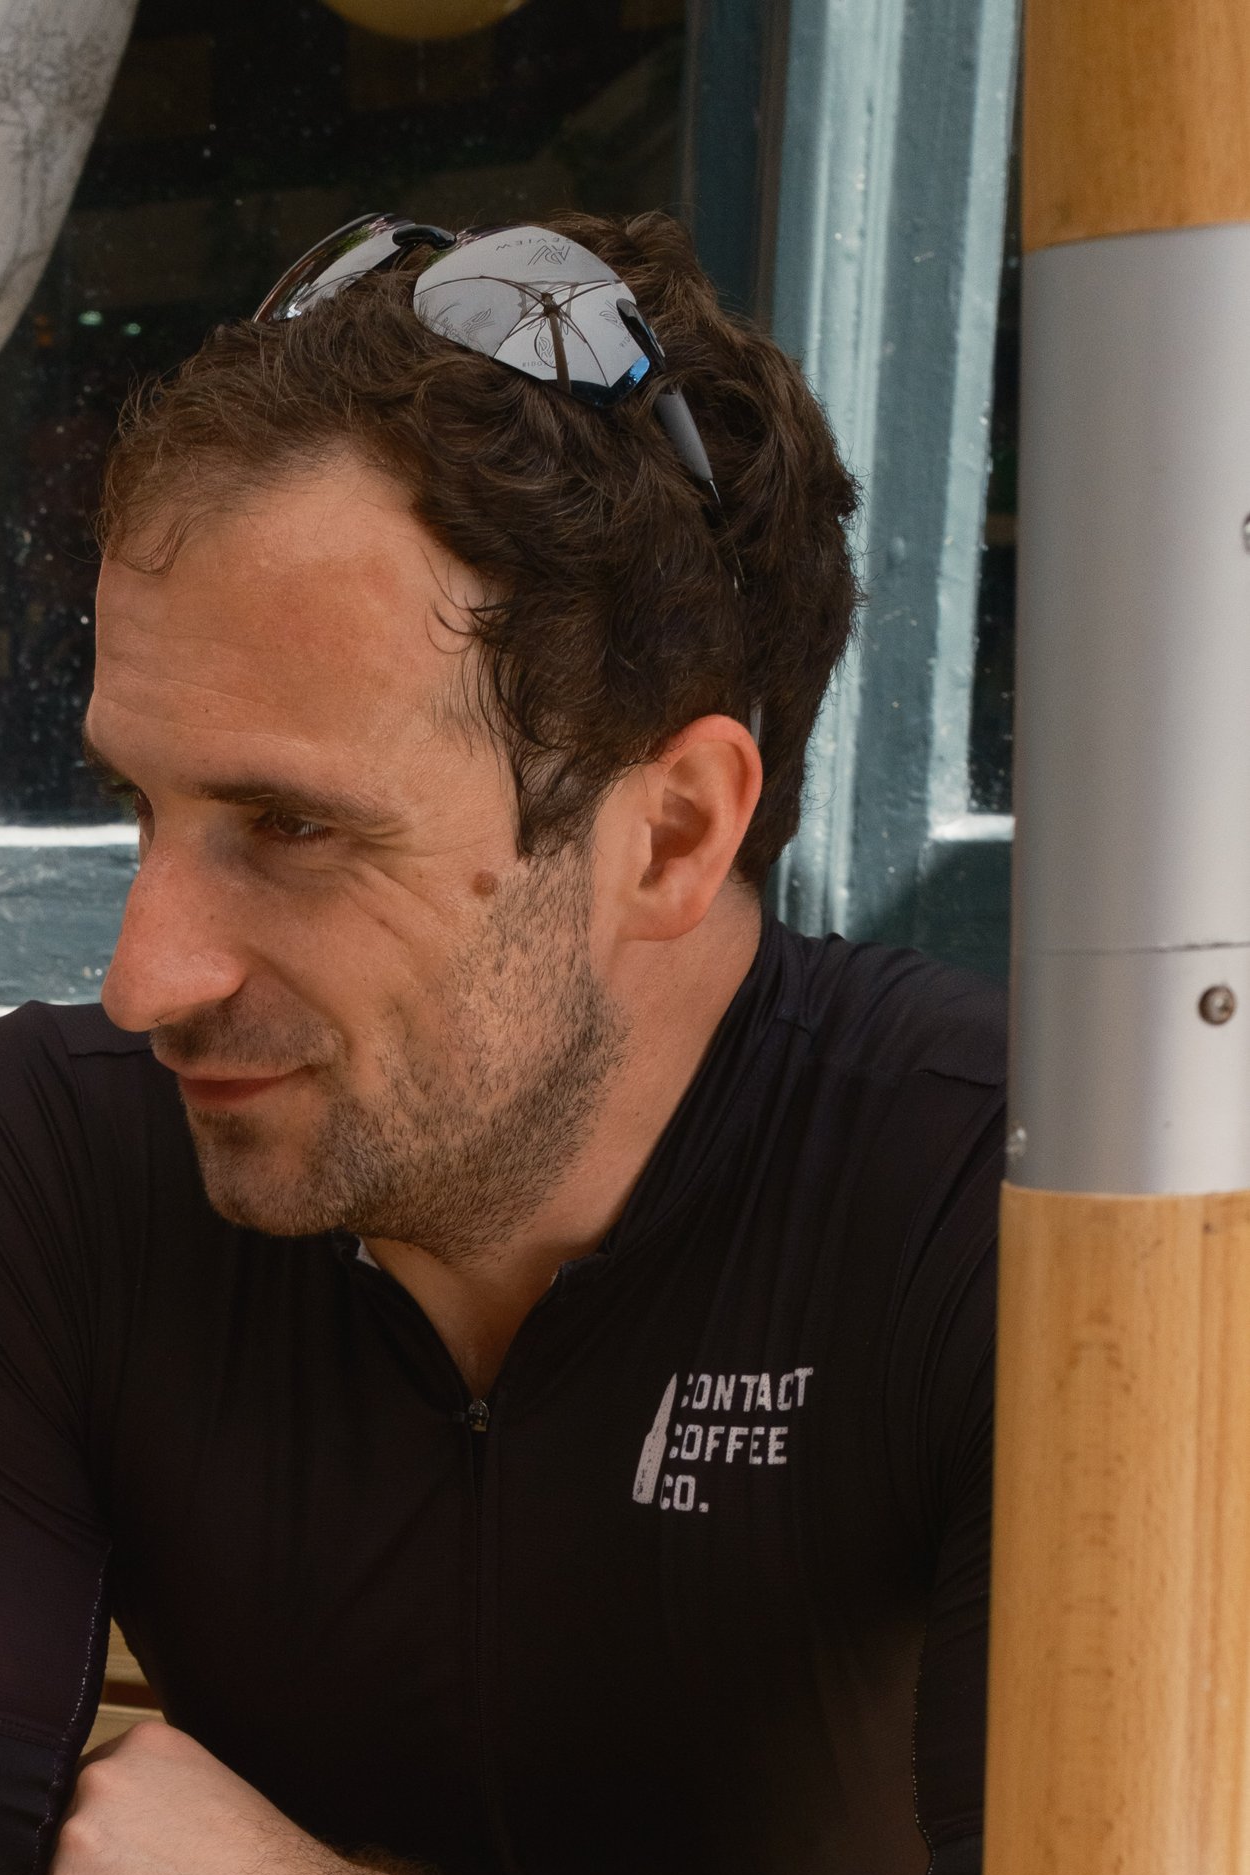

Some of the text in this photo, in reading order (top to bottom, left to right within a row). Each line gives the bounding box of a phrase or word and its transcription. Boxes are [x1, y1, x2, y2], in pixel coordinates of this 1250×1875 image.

[681, 1367, 814, 1412] CONTACT
[669, 1424, 789, 1465] COFFEE
[660, 1474, 710, 1513] CO.
